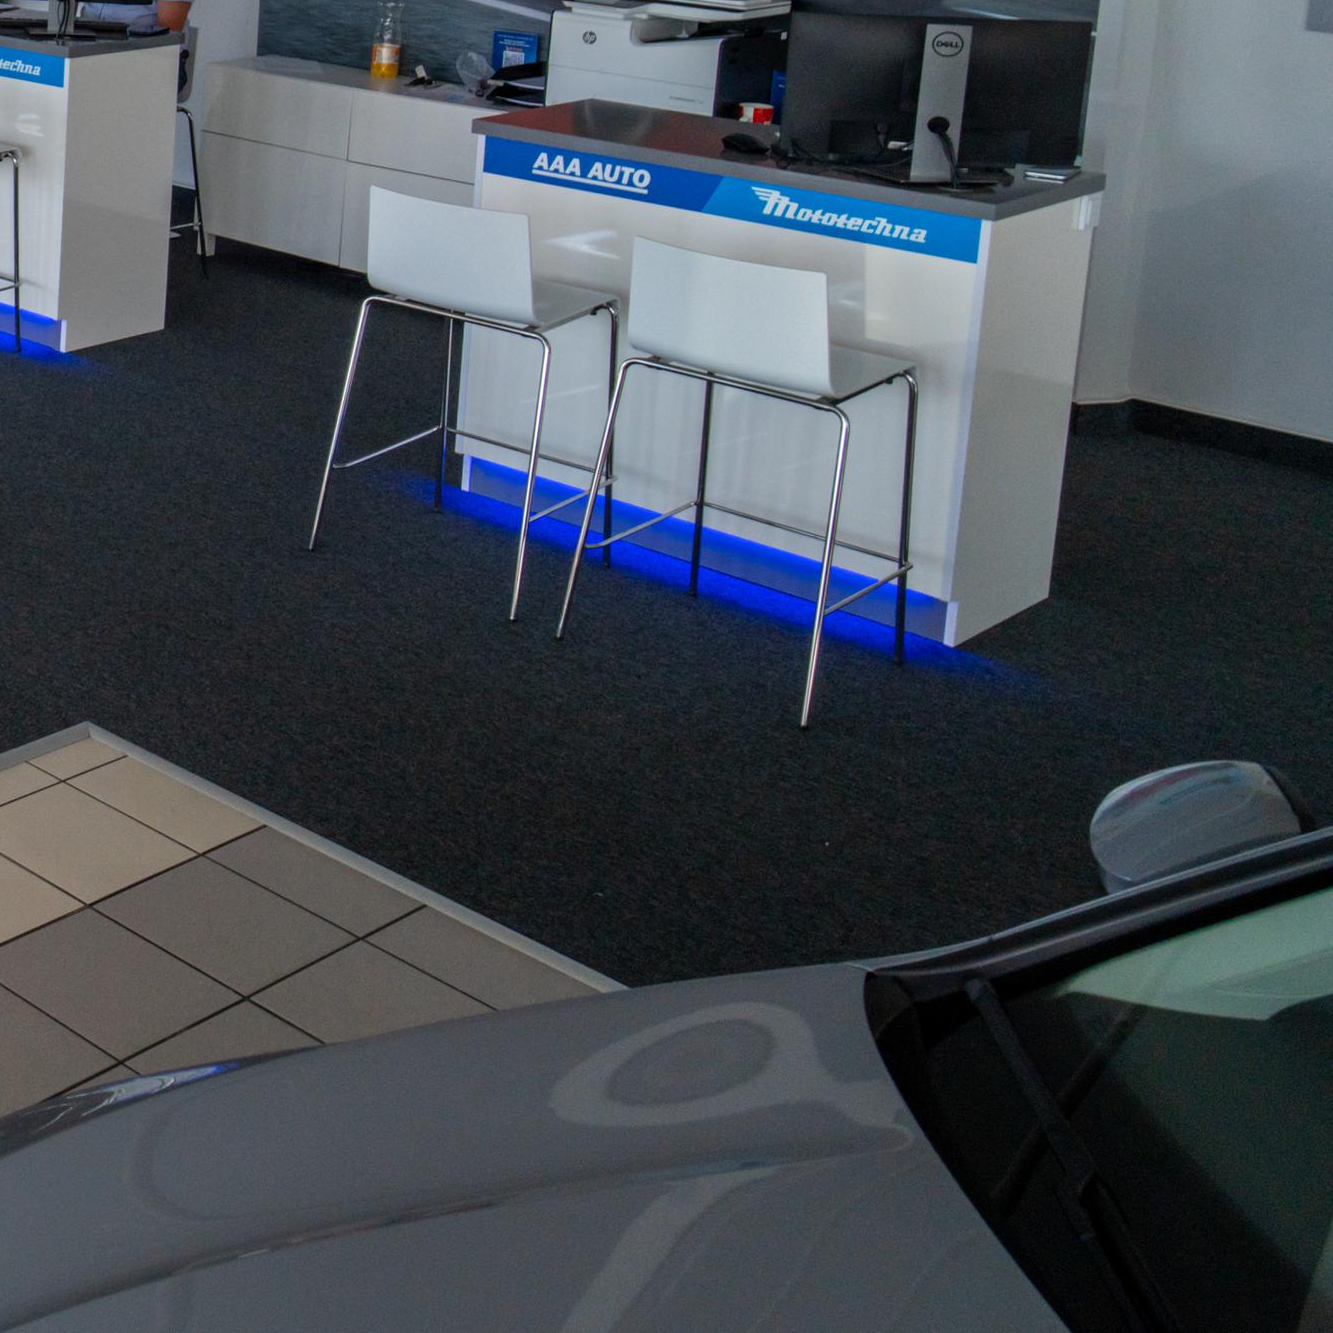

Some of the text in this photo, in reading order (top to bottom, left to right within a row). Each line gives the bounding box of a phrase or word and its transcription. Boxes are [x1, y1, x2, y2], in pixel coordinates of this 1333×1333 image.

[533, 152, 928, 244] AAA AUTO Mototechna
